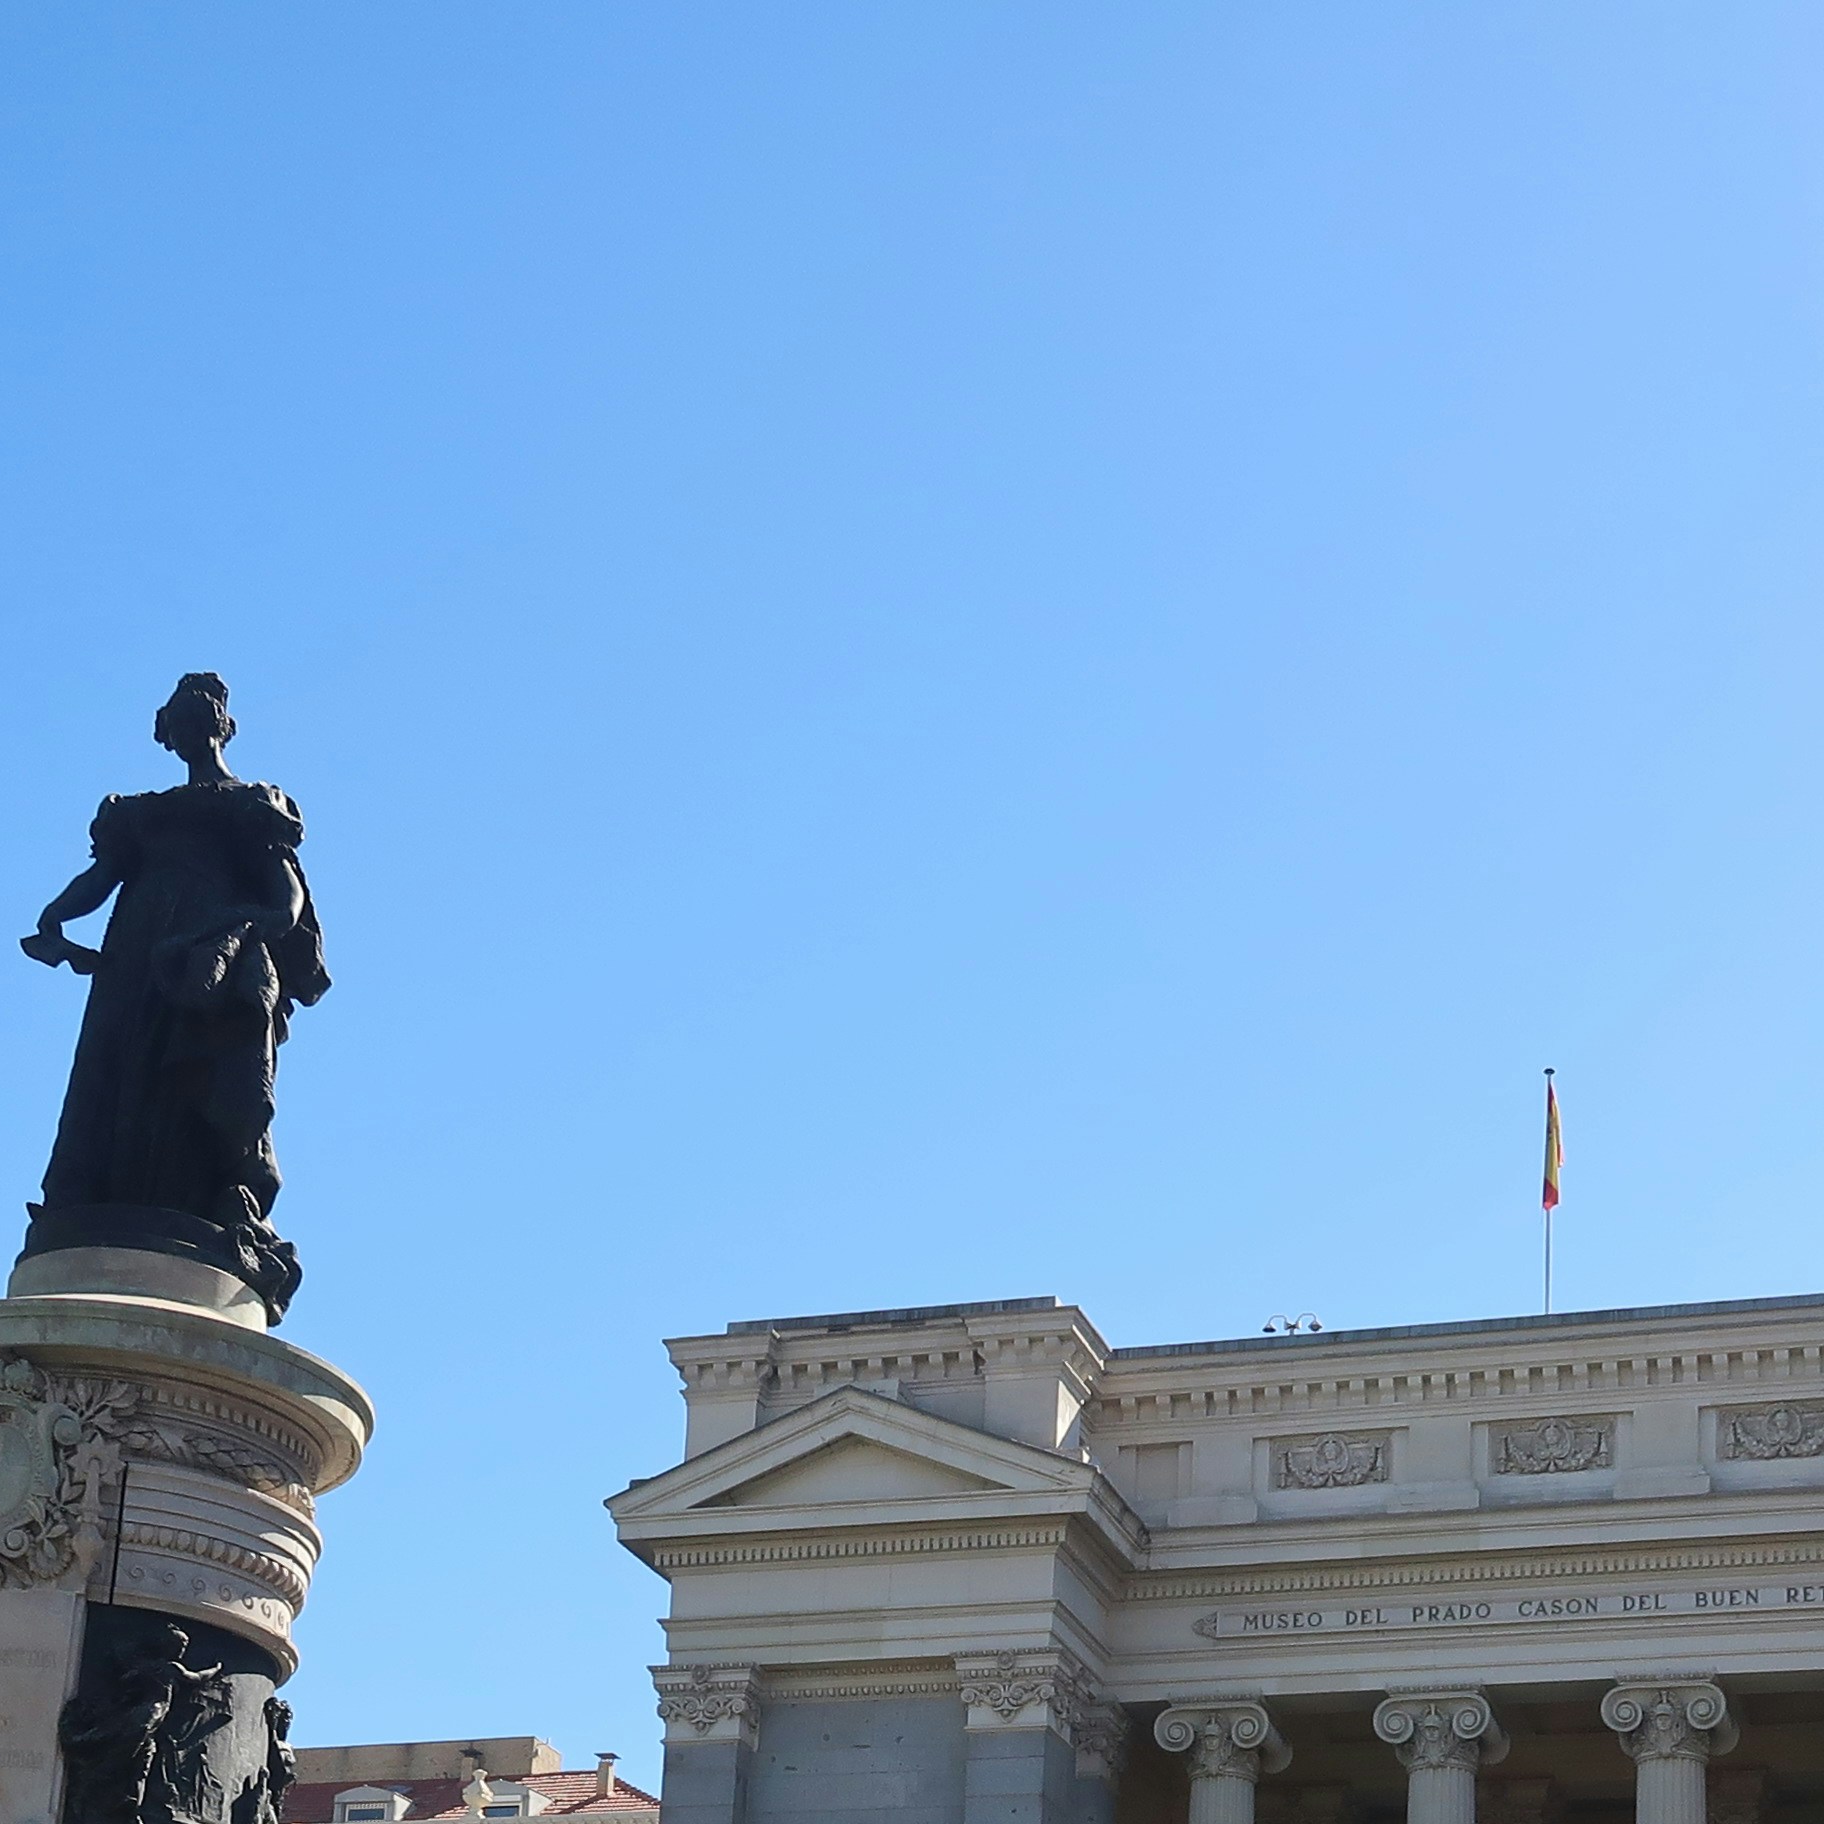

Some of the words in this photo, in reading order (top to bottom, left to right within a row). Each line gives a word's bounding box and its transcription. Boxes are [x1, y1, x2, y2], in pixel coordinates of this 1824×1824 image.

[1242, 1609, 1324, 1632] MUSEO
[1344, 1607, 1389, 1627] DEL
[1411, 1602, 1493, 1624] PRADO
[1517, 1597, 1600, 1619] CASON
[1621, 1593, 1668, 1613] DEL
[1694, 1588, 1761, 1609] BUEN
